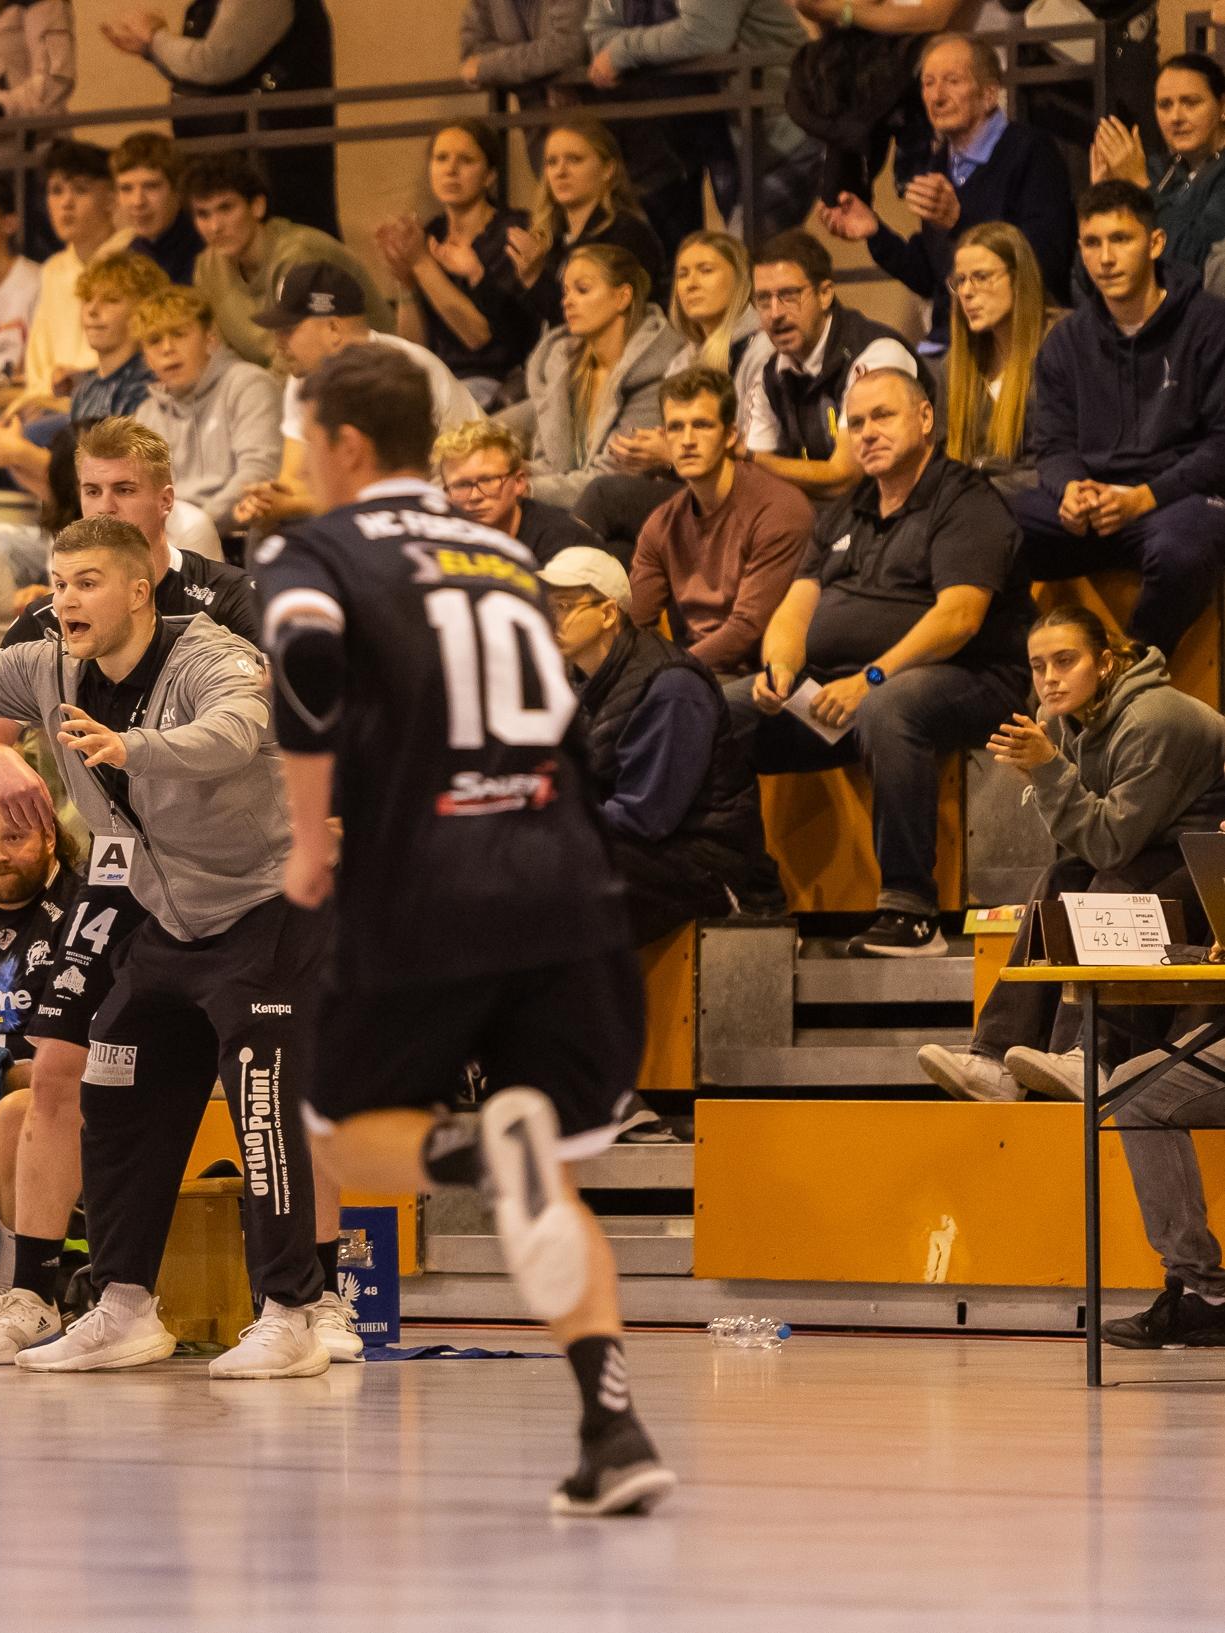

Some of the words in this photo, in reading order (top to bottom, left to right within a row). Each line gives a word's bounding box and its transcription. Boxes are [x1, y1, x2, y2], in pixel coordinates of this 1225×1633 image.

[424, 587, 578, 750] 10
[96, 843, 128, 869] A
[1096, 911, 1114, 925] 42
[65, 901, 118, 954] 14
[1094, 931, 1109, 946] 43
[1113, 932, 1129, 946] 24
[251, 1003, 291, 1015] Kempa
[364, 1286, 378, 1296] 48
[356, 1321, 388, 1332] CHHEIM
